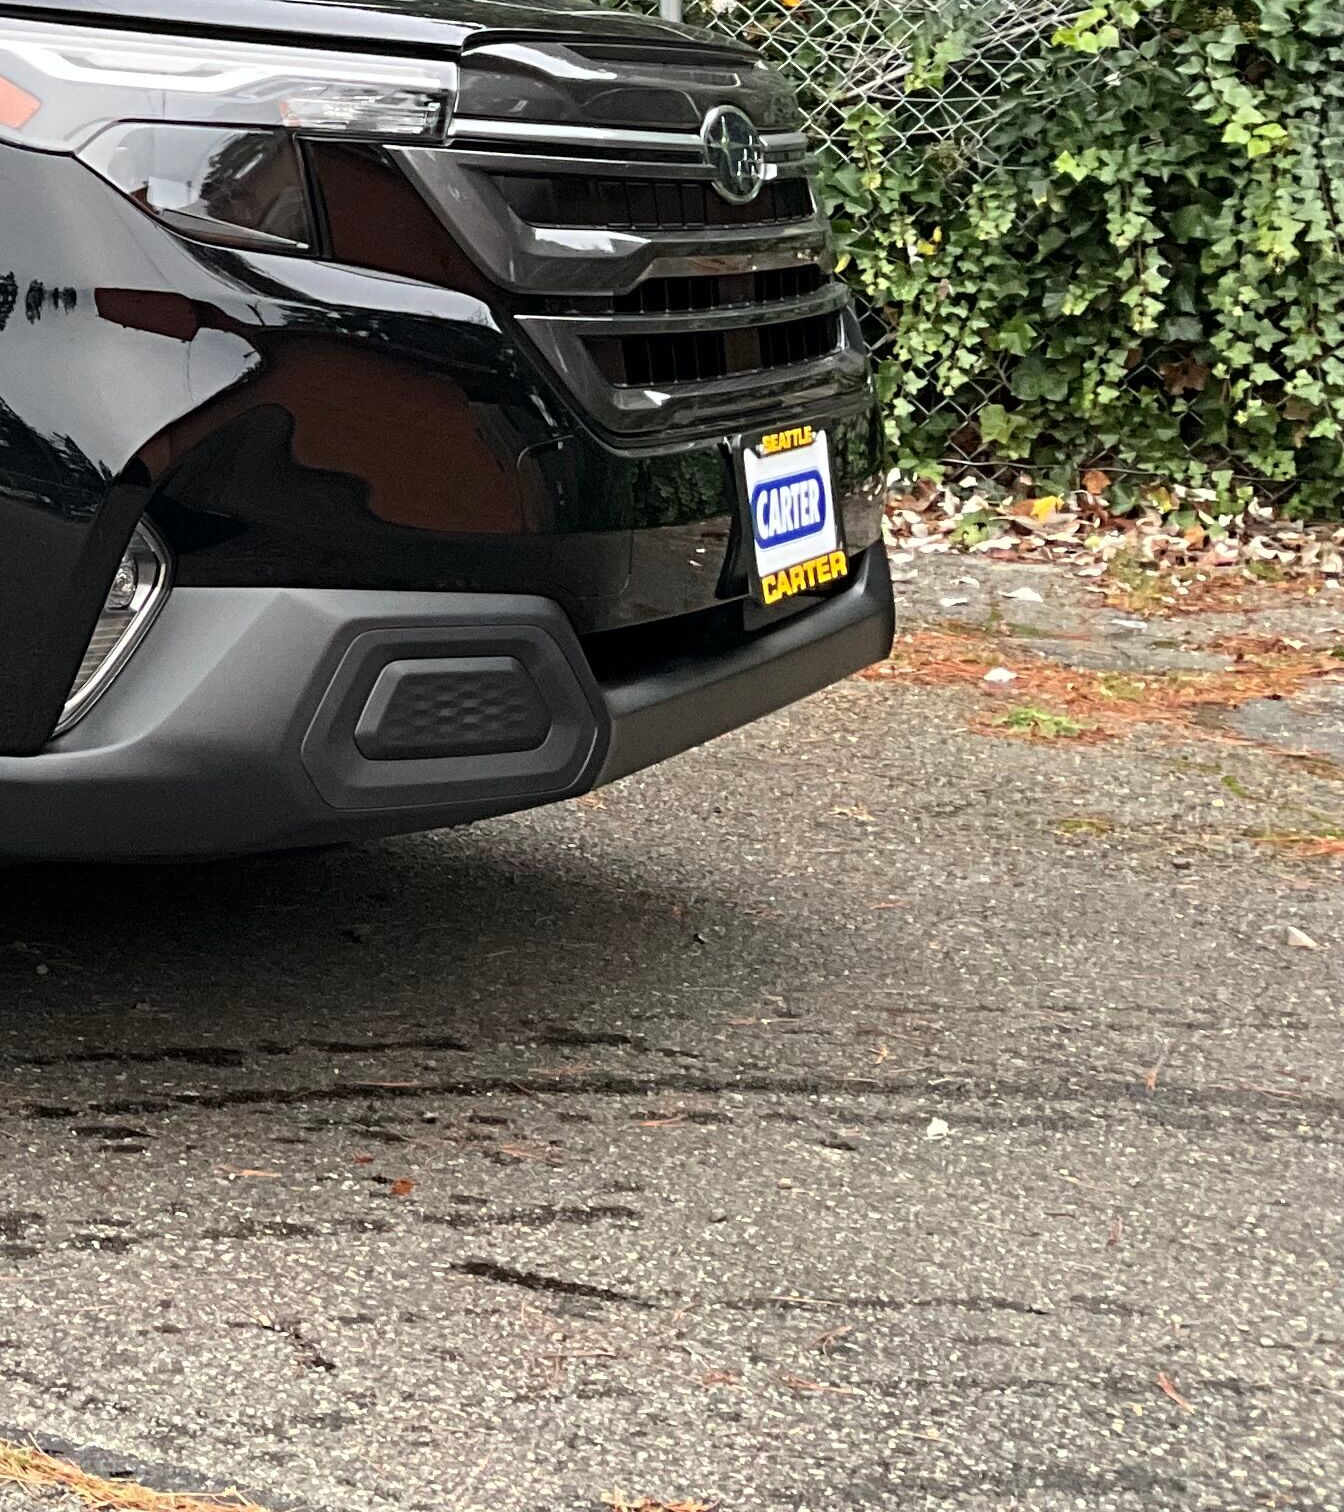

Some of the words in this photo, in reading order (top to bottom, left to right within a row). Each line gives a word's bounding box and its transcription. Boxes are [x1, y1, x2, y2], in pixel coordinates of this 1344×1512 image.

[762, 426, 812, 451] SEATTLE
[757, 478, 820, 539] CARTER
[762, 552, 848, 604] CARTER
